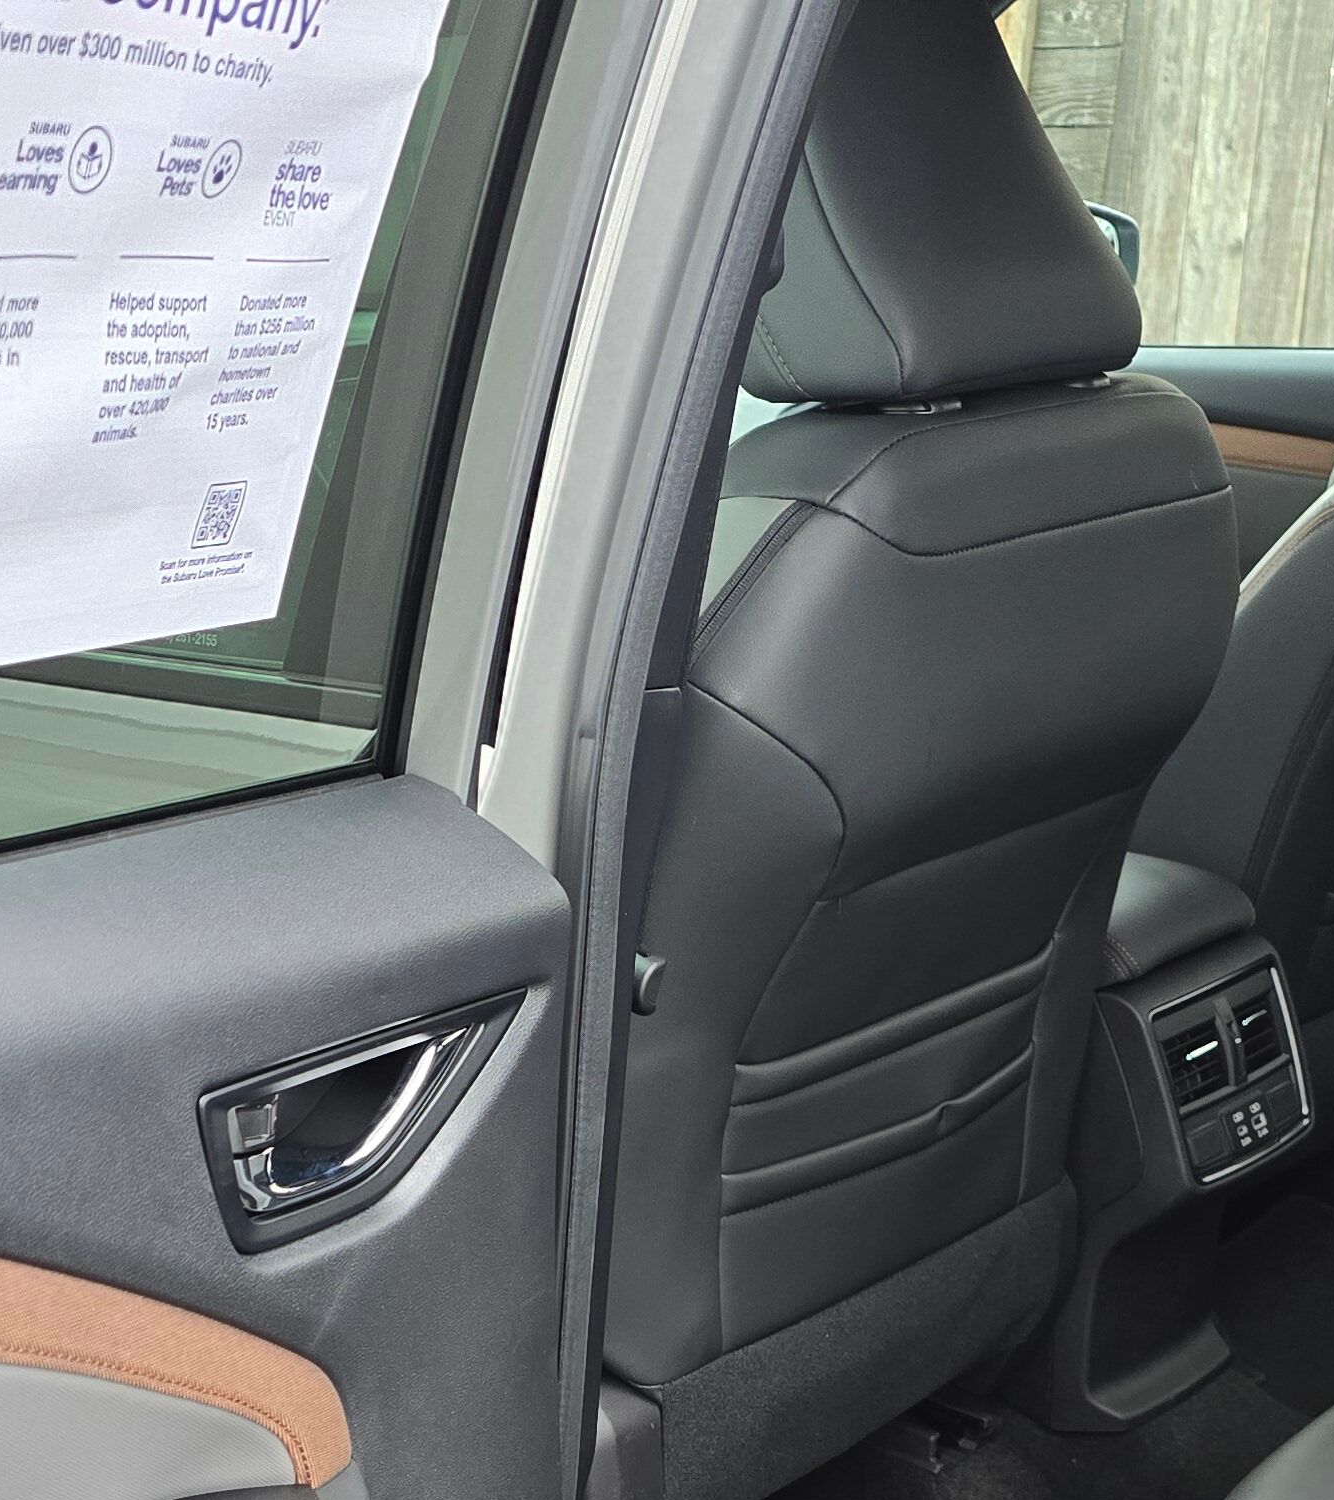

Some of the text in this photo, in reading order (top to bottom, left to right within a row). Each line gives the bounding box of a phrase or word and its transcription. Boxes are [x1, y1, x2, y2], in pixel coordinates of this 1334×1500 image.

[36, 32, 75, 54] over
[79, 30, 122, 61] $300
[124, 40, 187, 71] million
[192, 50, 210, 74] to
[214, 55, 273, 88] charity.
[29, 122, 71, 136] SUBARU
[16, 139, 64, 163] Loves
[170, 134, 210, 150] SUBARU
[284, 140, 323, 156] SUBARU
[157, 149, 201, 174] Loves
[275, 157, 321, 183] share
[159, 177, 194, 198] Pets
[269, 183, 330, 210] the love
[263, 209, 296, 227] EVENT
[7, 298, 39, 312] more
[109, 292, 207, 316] Helped support
[240, 294, 307, 312] Donated more
[107, 321, 190, 343] the adoption,
[234, 318, 258, 336] than
[283, 316, 315, 333] million
[8, 349, 19, 366] in
[105, 347, 209, 368] rescue, transport
[228, 340, 301, 360] to national and
[103, 371, 182, 393] and health of
[218, 365, 271, 383] hometown
[210, 387, 279, 407] charities over
[99, 397, 170, 419] over 420,000
[206, 412, 249, 432] 15 years.
[92, 424, 138, 443] animals.
[159, 551, 253, 571] Scan for more information on
[161, 575, 171, 584] the
[173, 573, 197, 582] Subaru
[198, 569, 213, 579] Love
